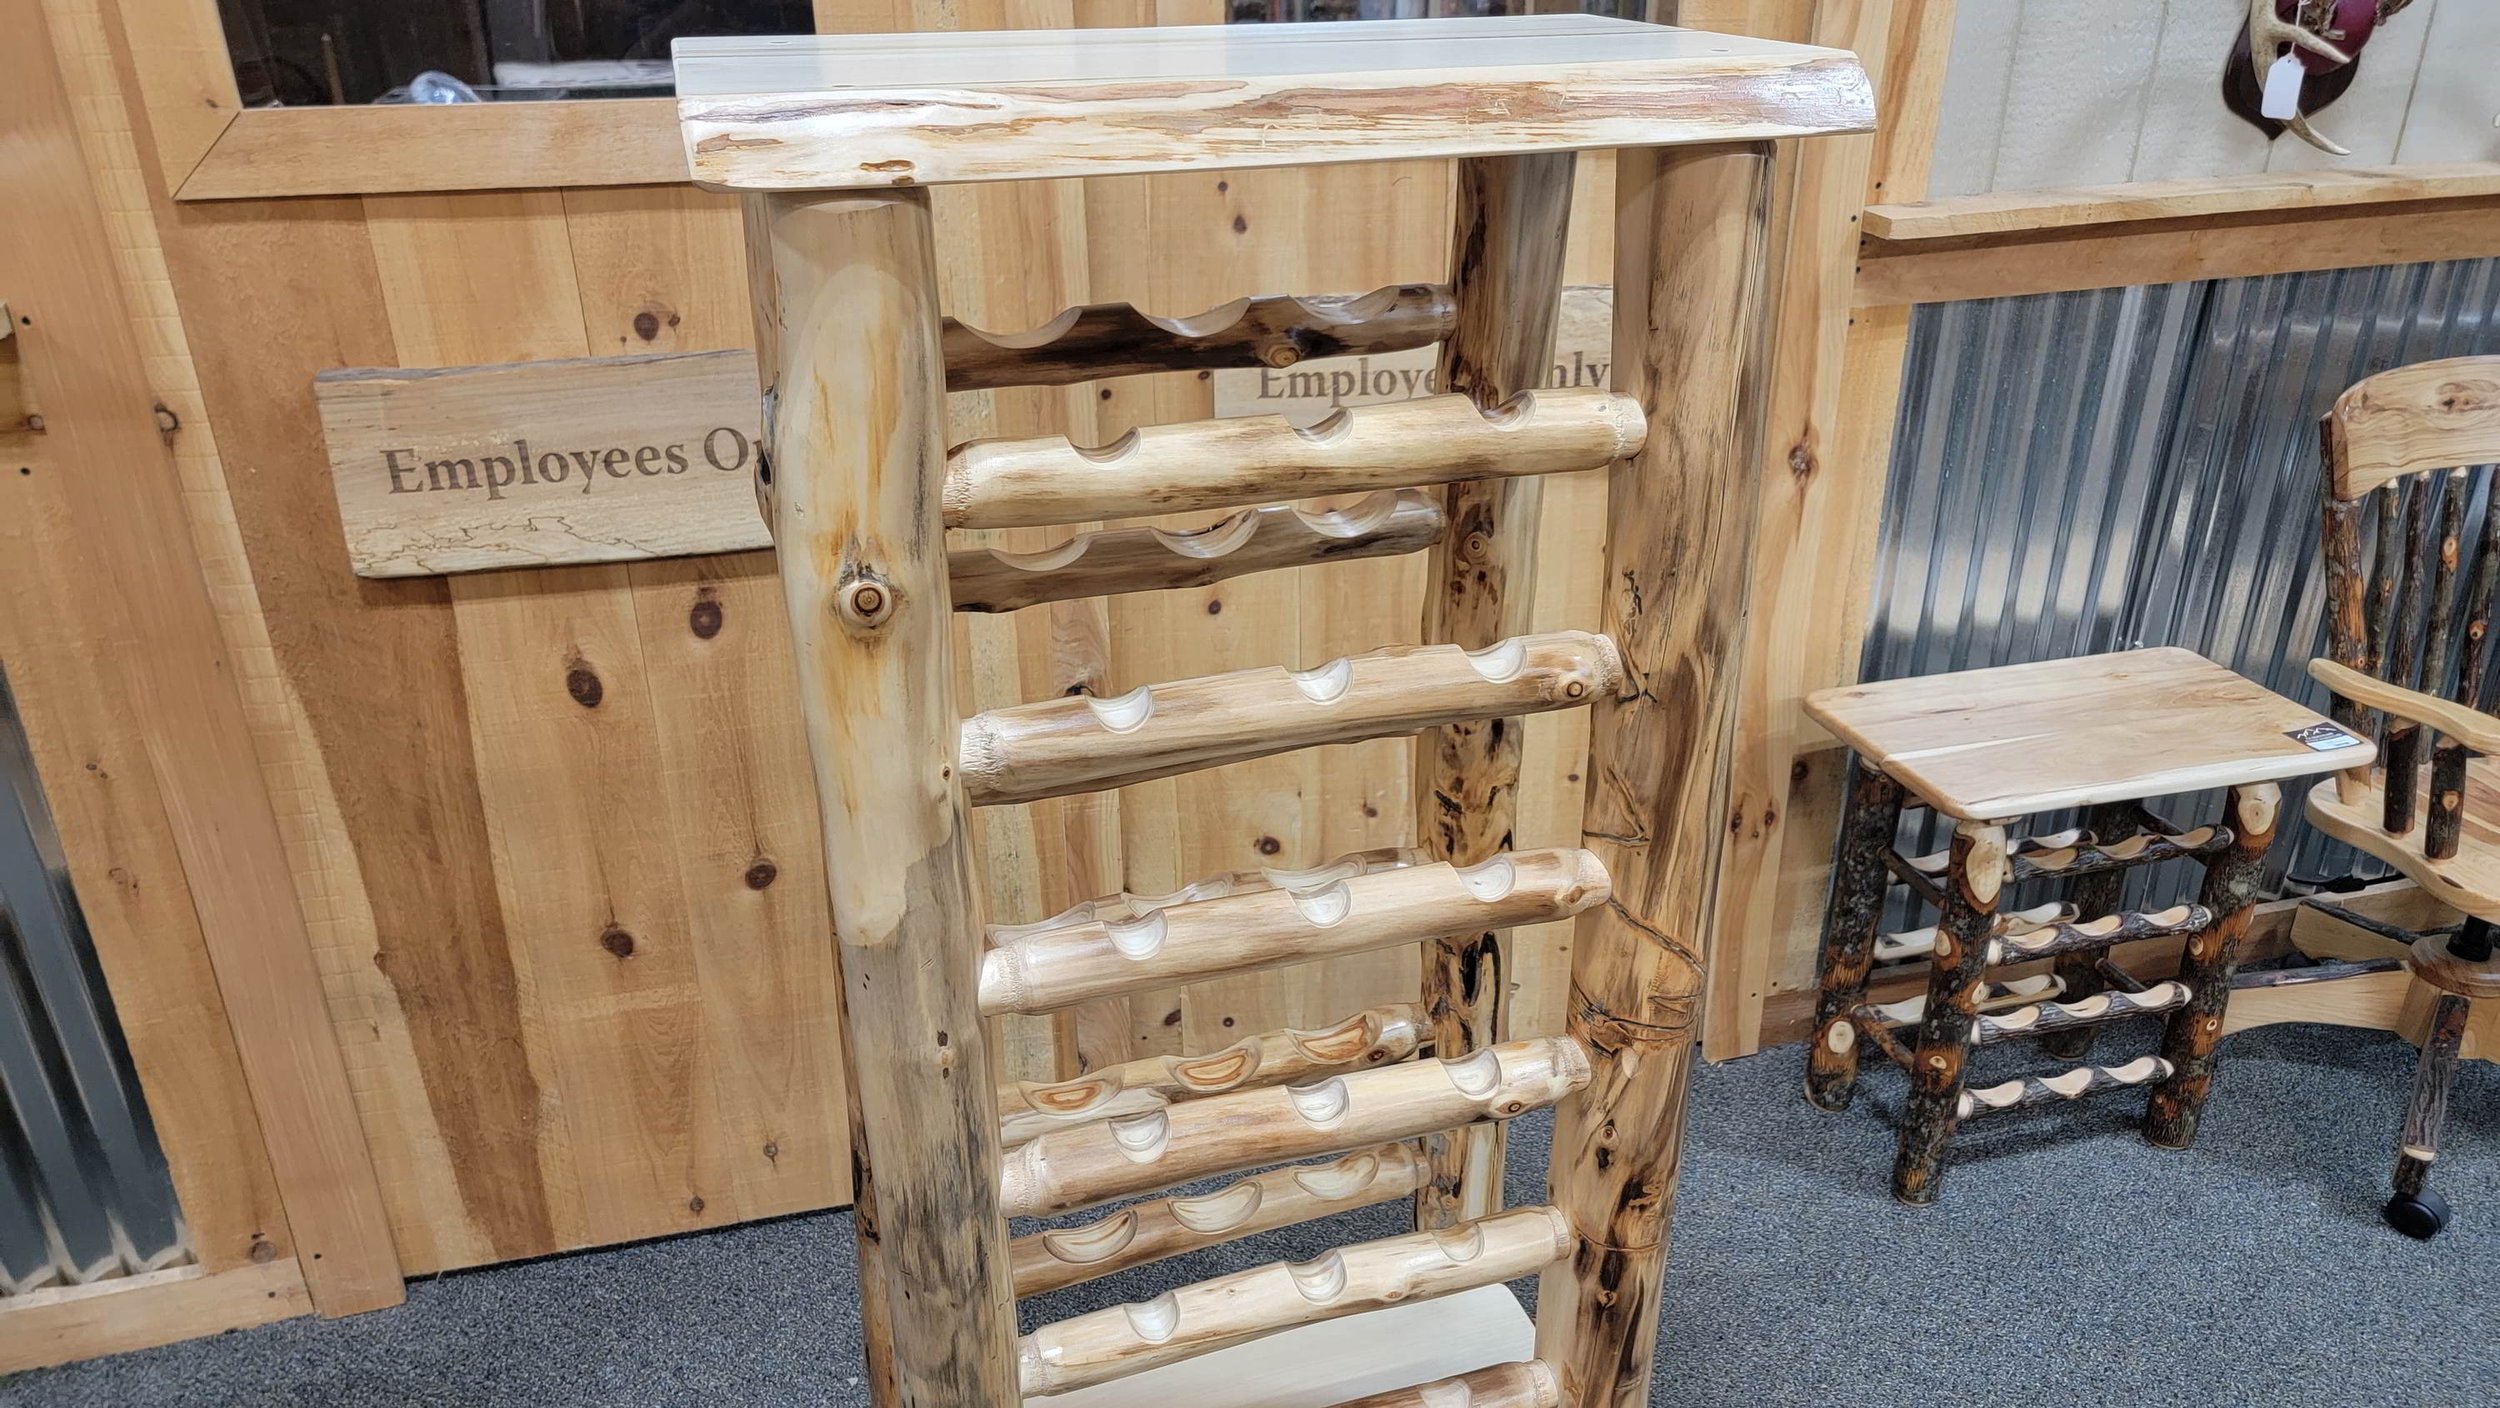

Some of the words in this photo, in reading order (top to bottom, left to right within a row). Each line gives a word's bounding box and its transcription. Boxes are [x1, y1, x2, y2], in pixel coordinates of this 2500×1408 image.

[1257, 357, 1436, 408] Employe
[1552, 350, 1610, 388] nly
[379, 437, 690, 501] Employees
[703, 426, 763, 472] O
